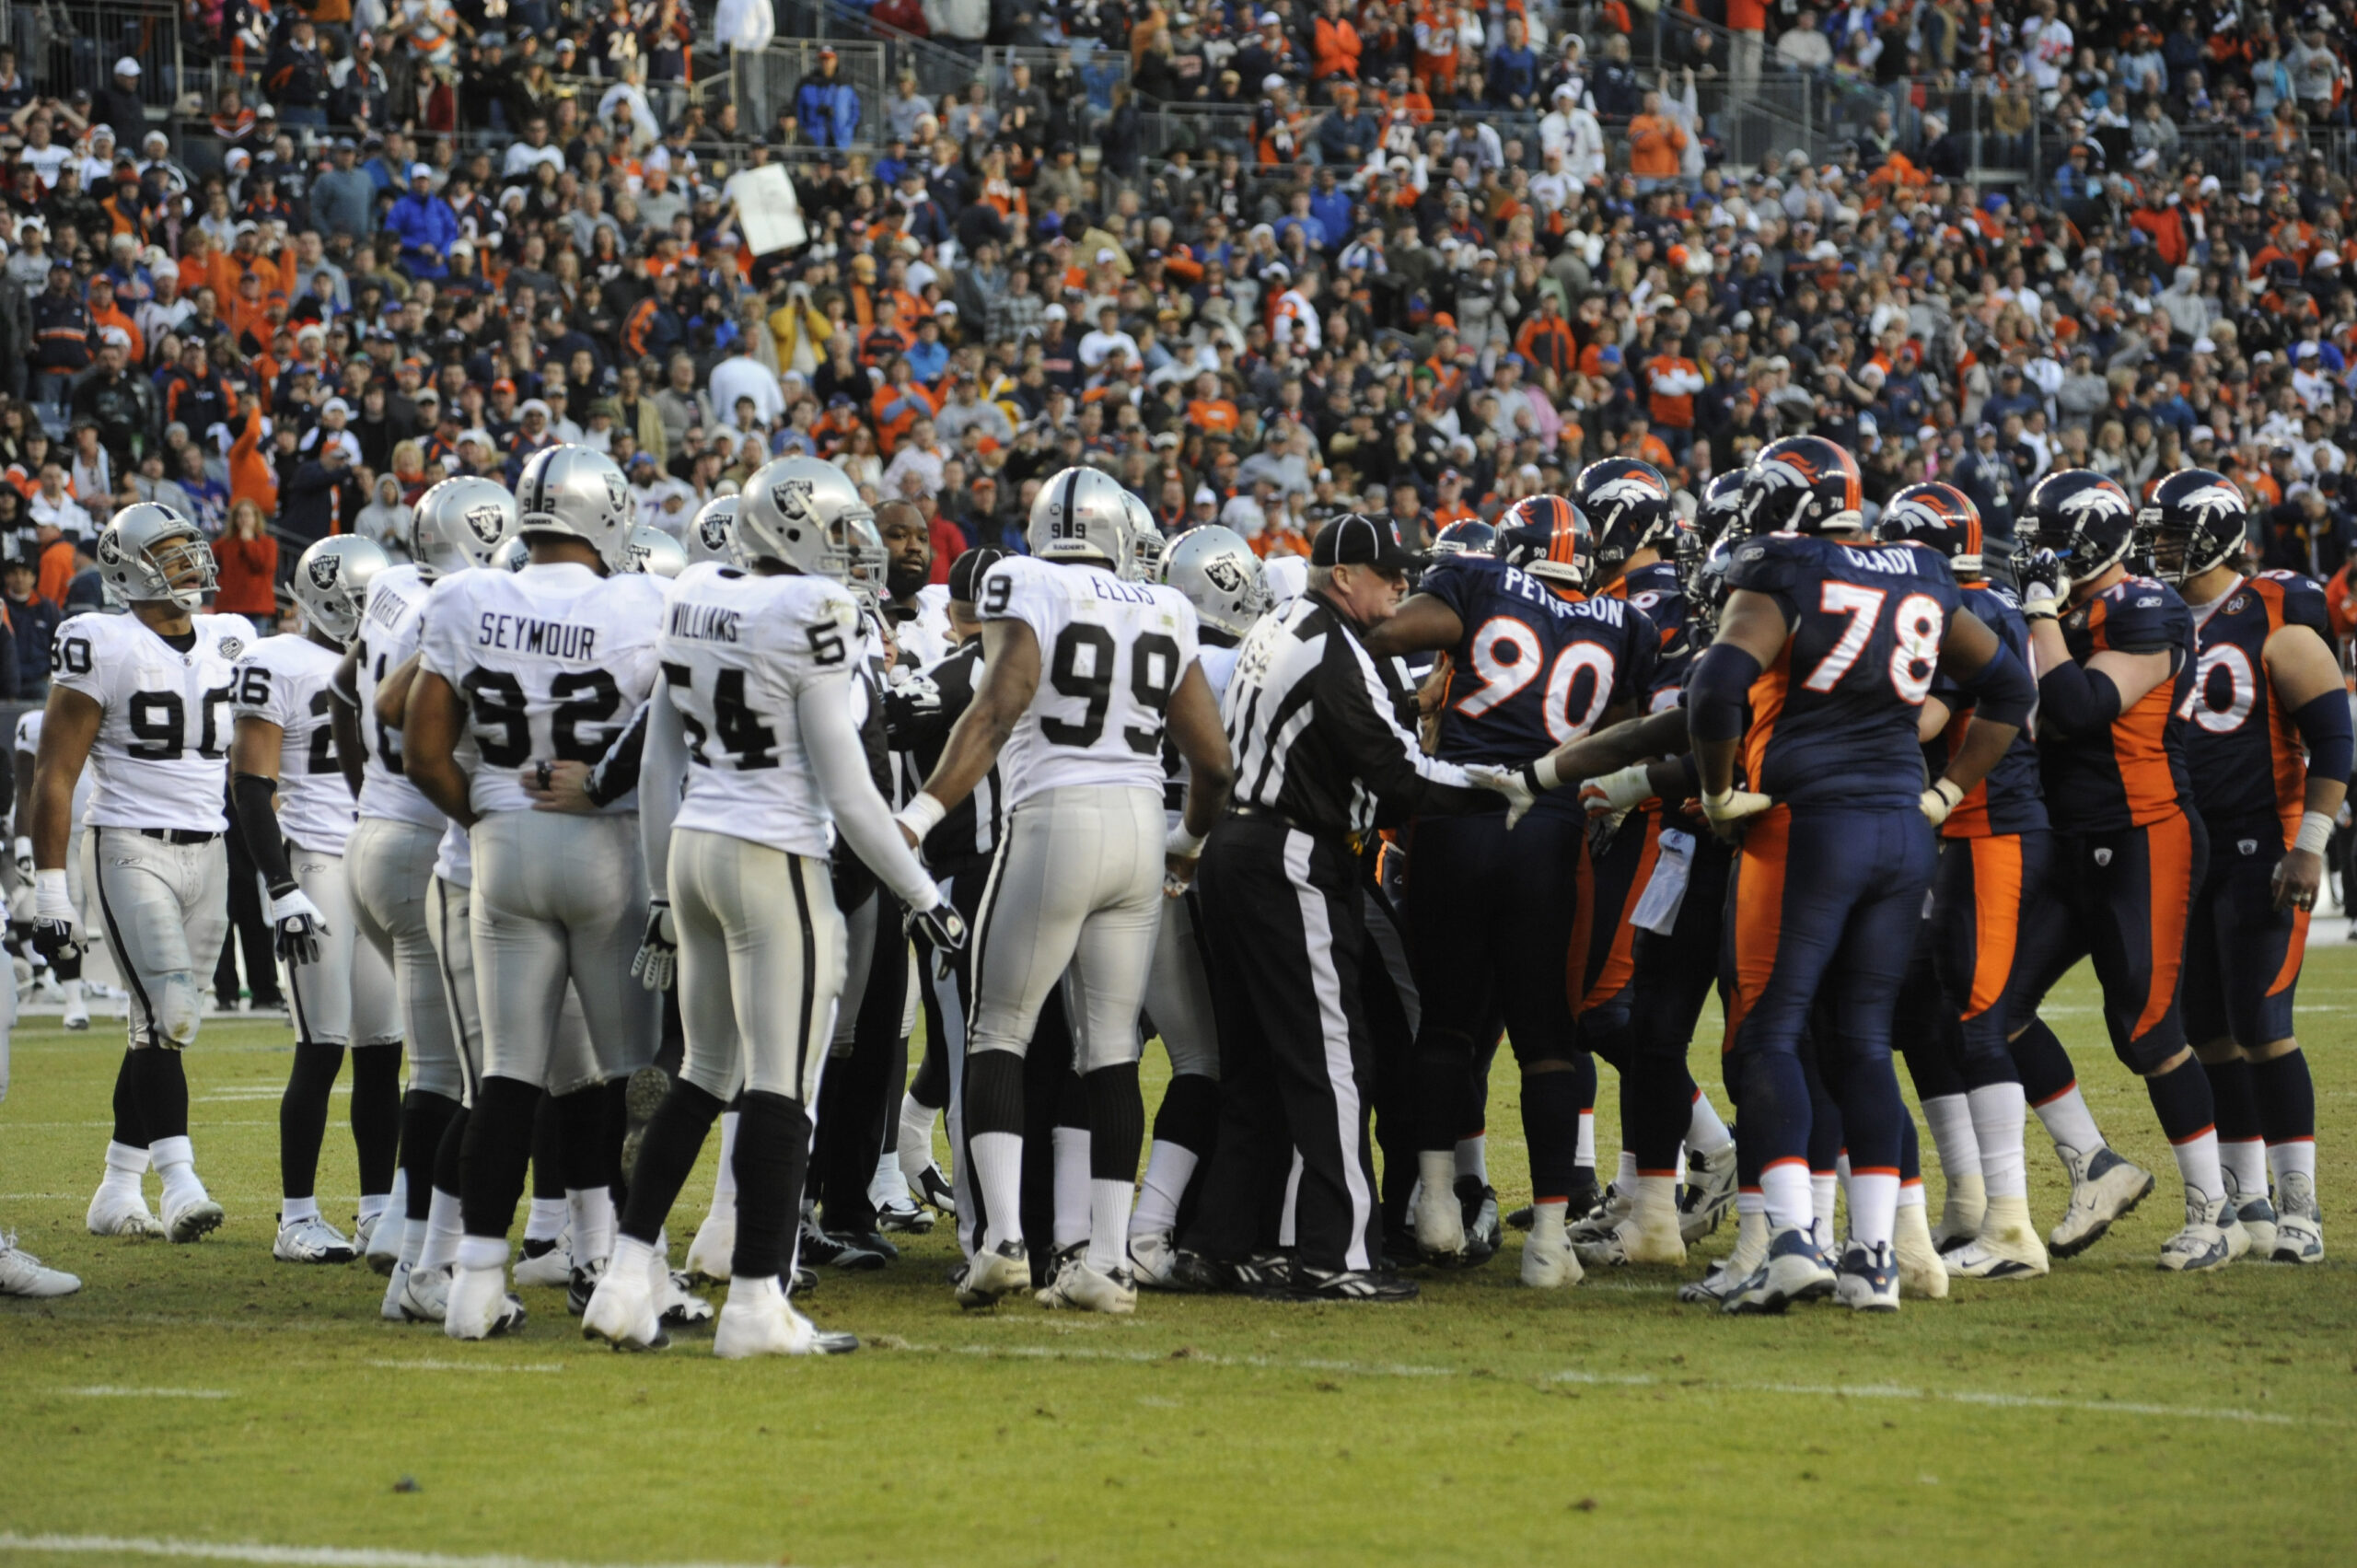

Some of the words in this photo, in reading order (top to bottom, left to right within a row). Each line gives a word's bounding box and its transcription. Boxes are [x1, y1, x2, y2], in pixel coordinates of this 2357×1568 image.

[1830, 496, 1845, 509] 78
[1091, 575, 1155, 605] ELLIS
[1533, 546, 1548, 559] 90
[1841, 544, 1919, 575] CLADY
[479, 611, 596, 661] SEYMOUR
[1803, 580, 1944, 705] 78
[460, 665, 635, 770] 92
[660, 659, 781, 771] 54
[1039, 621, 1181, 755] 99
[1452, 614, 1616, 744] 90
